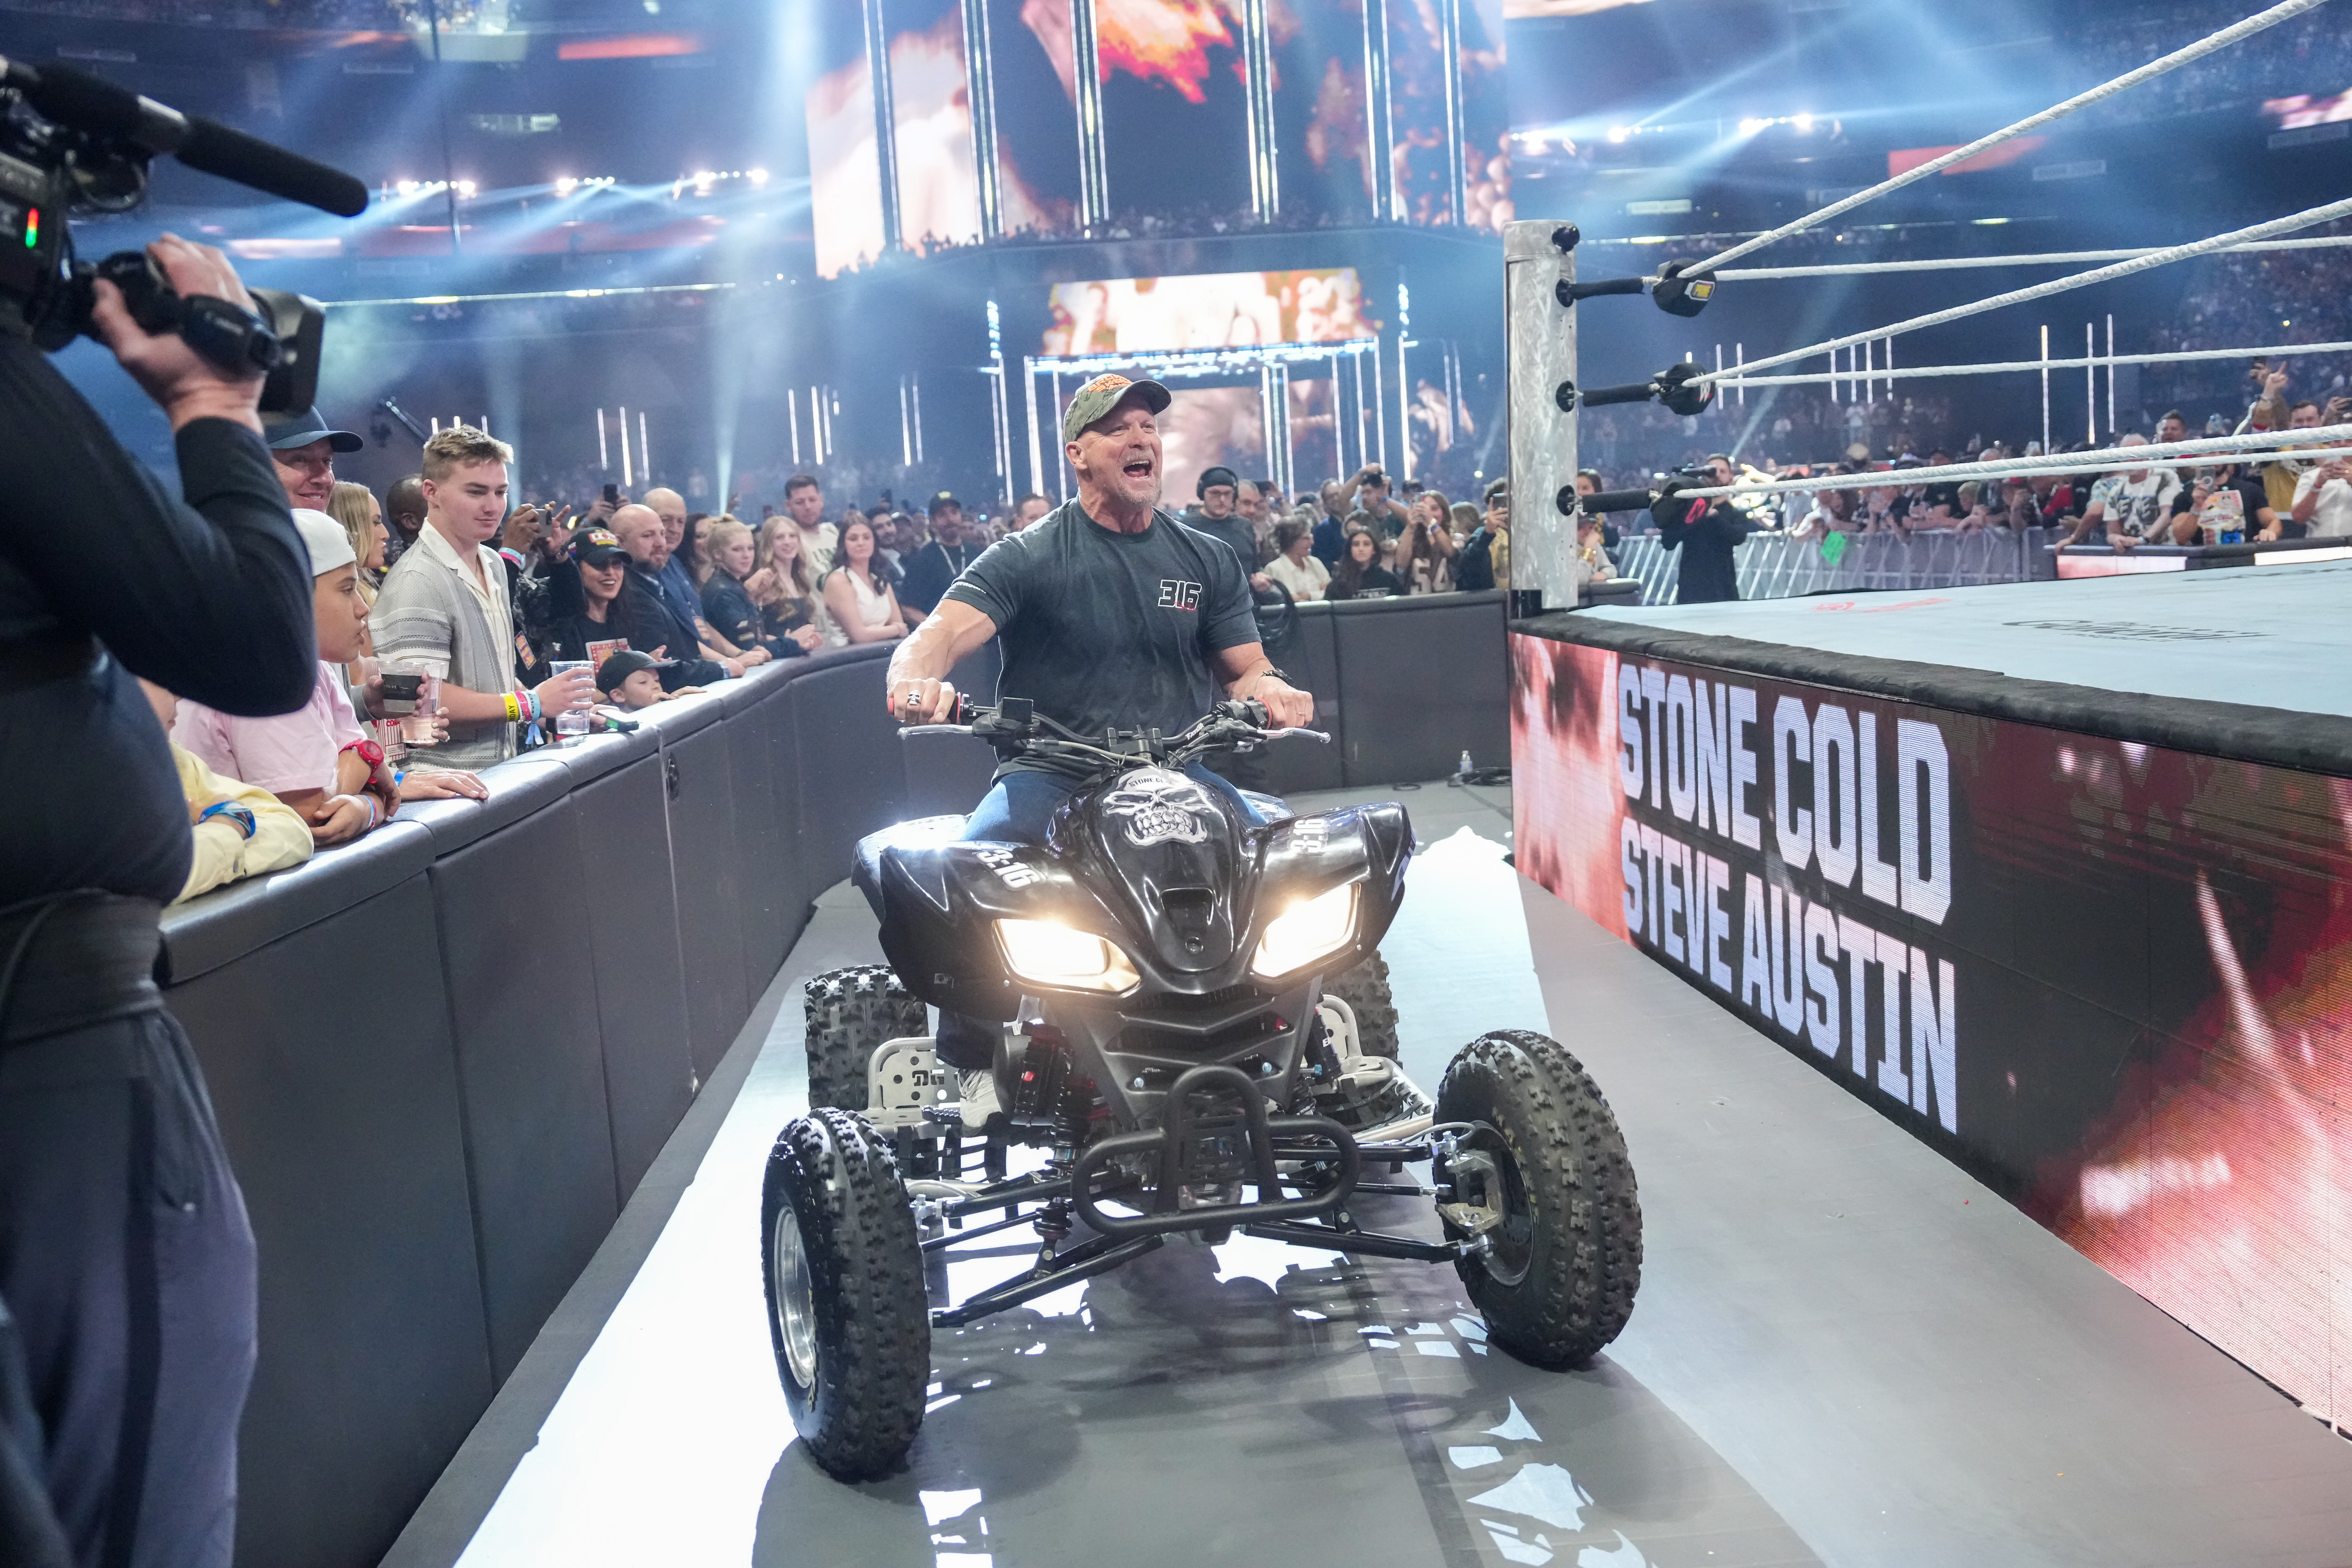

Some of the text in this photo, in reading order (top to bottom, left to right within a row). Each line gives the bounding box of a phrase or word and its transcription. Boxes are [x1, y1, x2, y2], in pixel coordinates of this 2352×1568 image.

[1158, 579, 1202, 610] 316
[1410, 557, 1457, 595] 54
[1129, 778, 1154, 787] STONE
[1618, 663, 1951, 925] STONE COLD
[1290, 818, 1325, 854] 3:16
[976, 849, 1040, 888] 3:16
[1620, 816, 1957, 1135] STEVE AUSTIN
